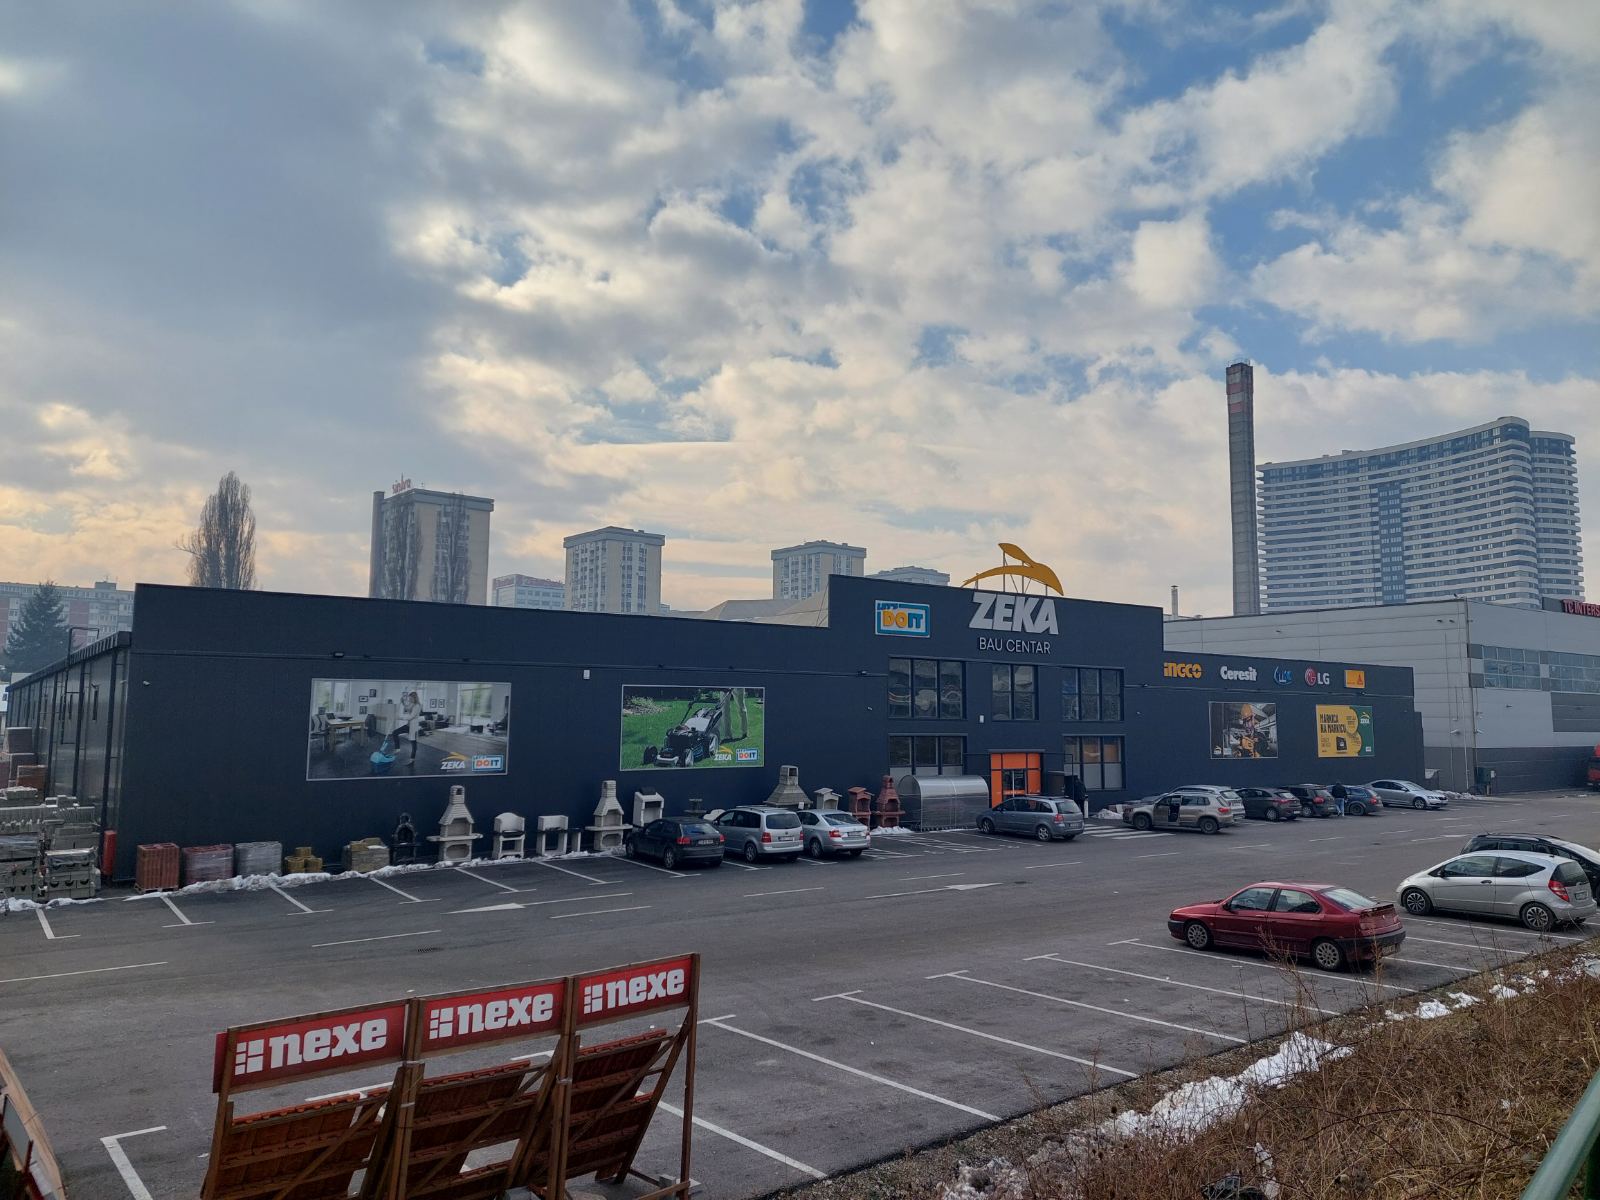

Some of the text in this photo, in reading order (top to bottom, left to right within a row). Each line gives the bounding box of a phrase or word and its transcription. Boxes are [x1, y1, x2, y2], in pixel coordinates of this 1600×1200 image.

[968, 592, 1060, 635] ZEKA
[1564, 600, 1574, 613] TC
[979, 637, 1052, 655] BAU CENTAR
[1220, 665, 1258, 682] Ceresit
[1317, 672, 1330, 685] LG
[440, 761, 466, 770] ZEKA
[606, 968, 685, 1010] nexe
[457, 993, 553, 1034] nexe
[269, 1018, 387, 1070] nexe
